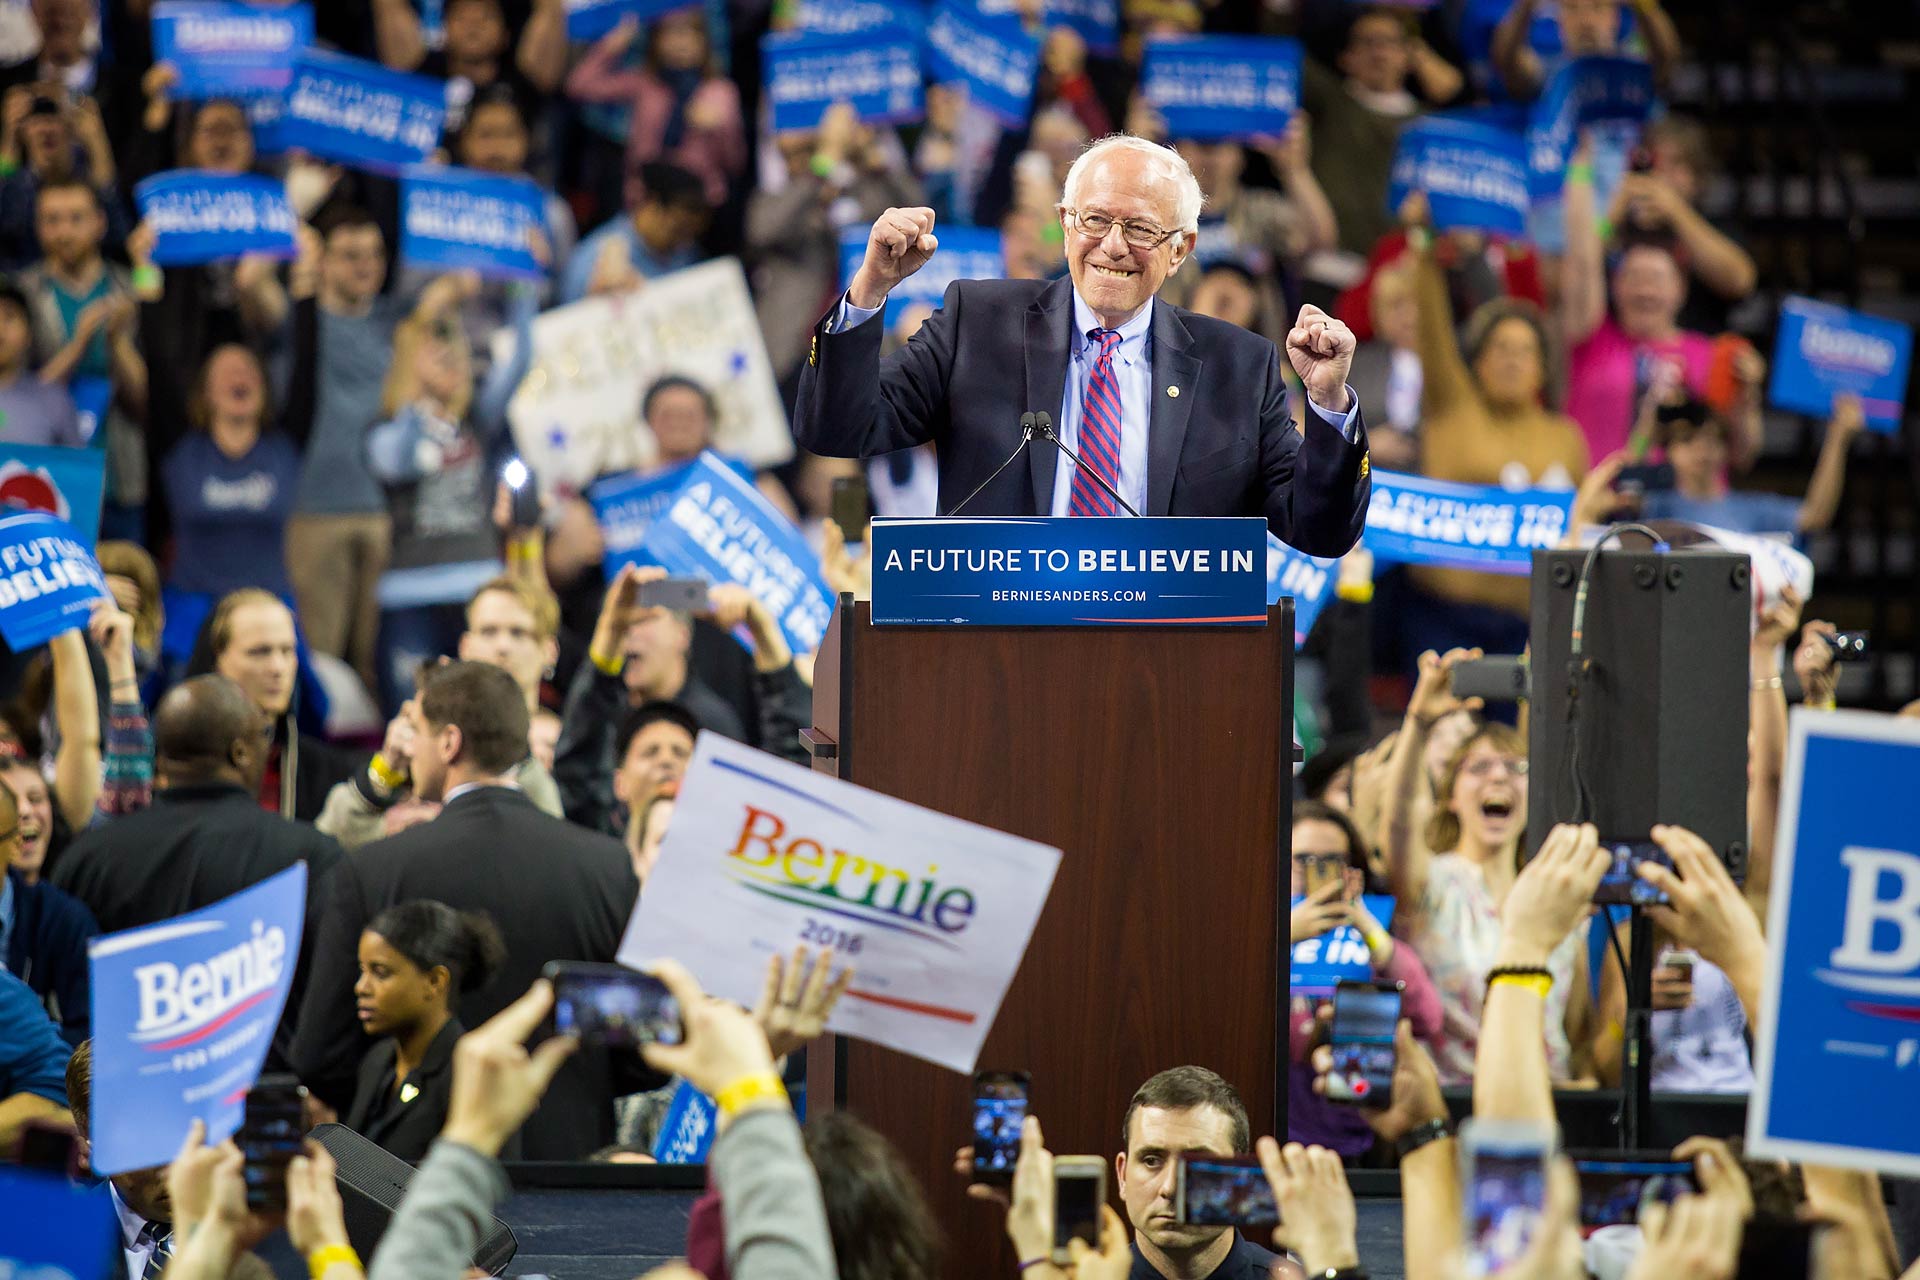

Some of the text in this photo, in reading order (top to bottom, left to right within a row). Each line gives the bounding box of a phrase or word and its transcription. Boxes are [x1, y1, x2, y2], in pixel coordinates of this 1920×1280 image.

[884, 549, 904, 572] A
[910, 549, 1022, 572] FUTURE
[1028, 549, 1070, 572] TO
[1078, 549, 1210, 572] BELIEVE
[1220, 549, 1254, 572] IN
[992, 590, 1147, 603] BERNIESANDERS.COM
[728, 804, 976, 934] Bernie
[798, 917, 863, 955] 2016
[134, 919, 287, 1031] Bernie
